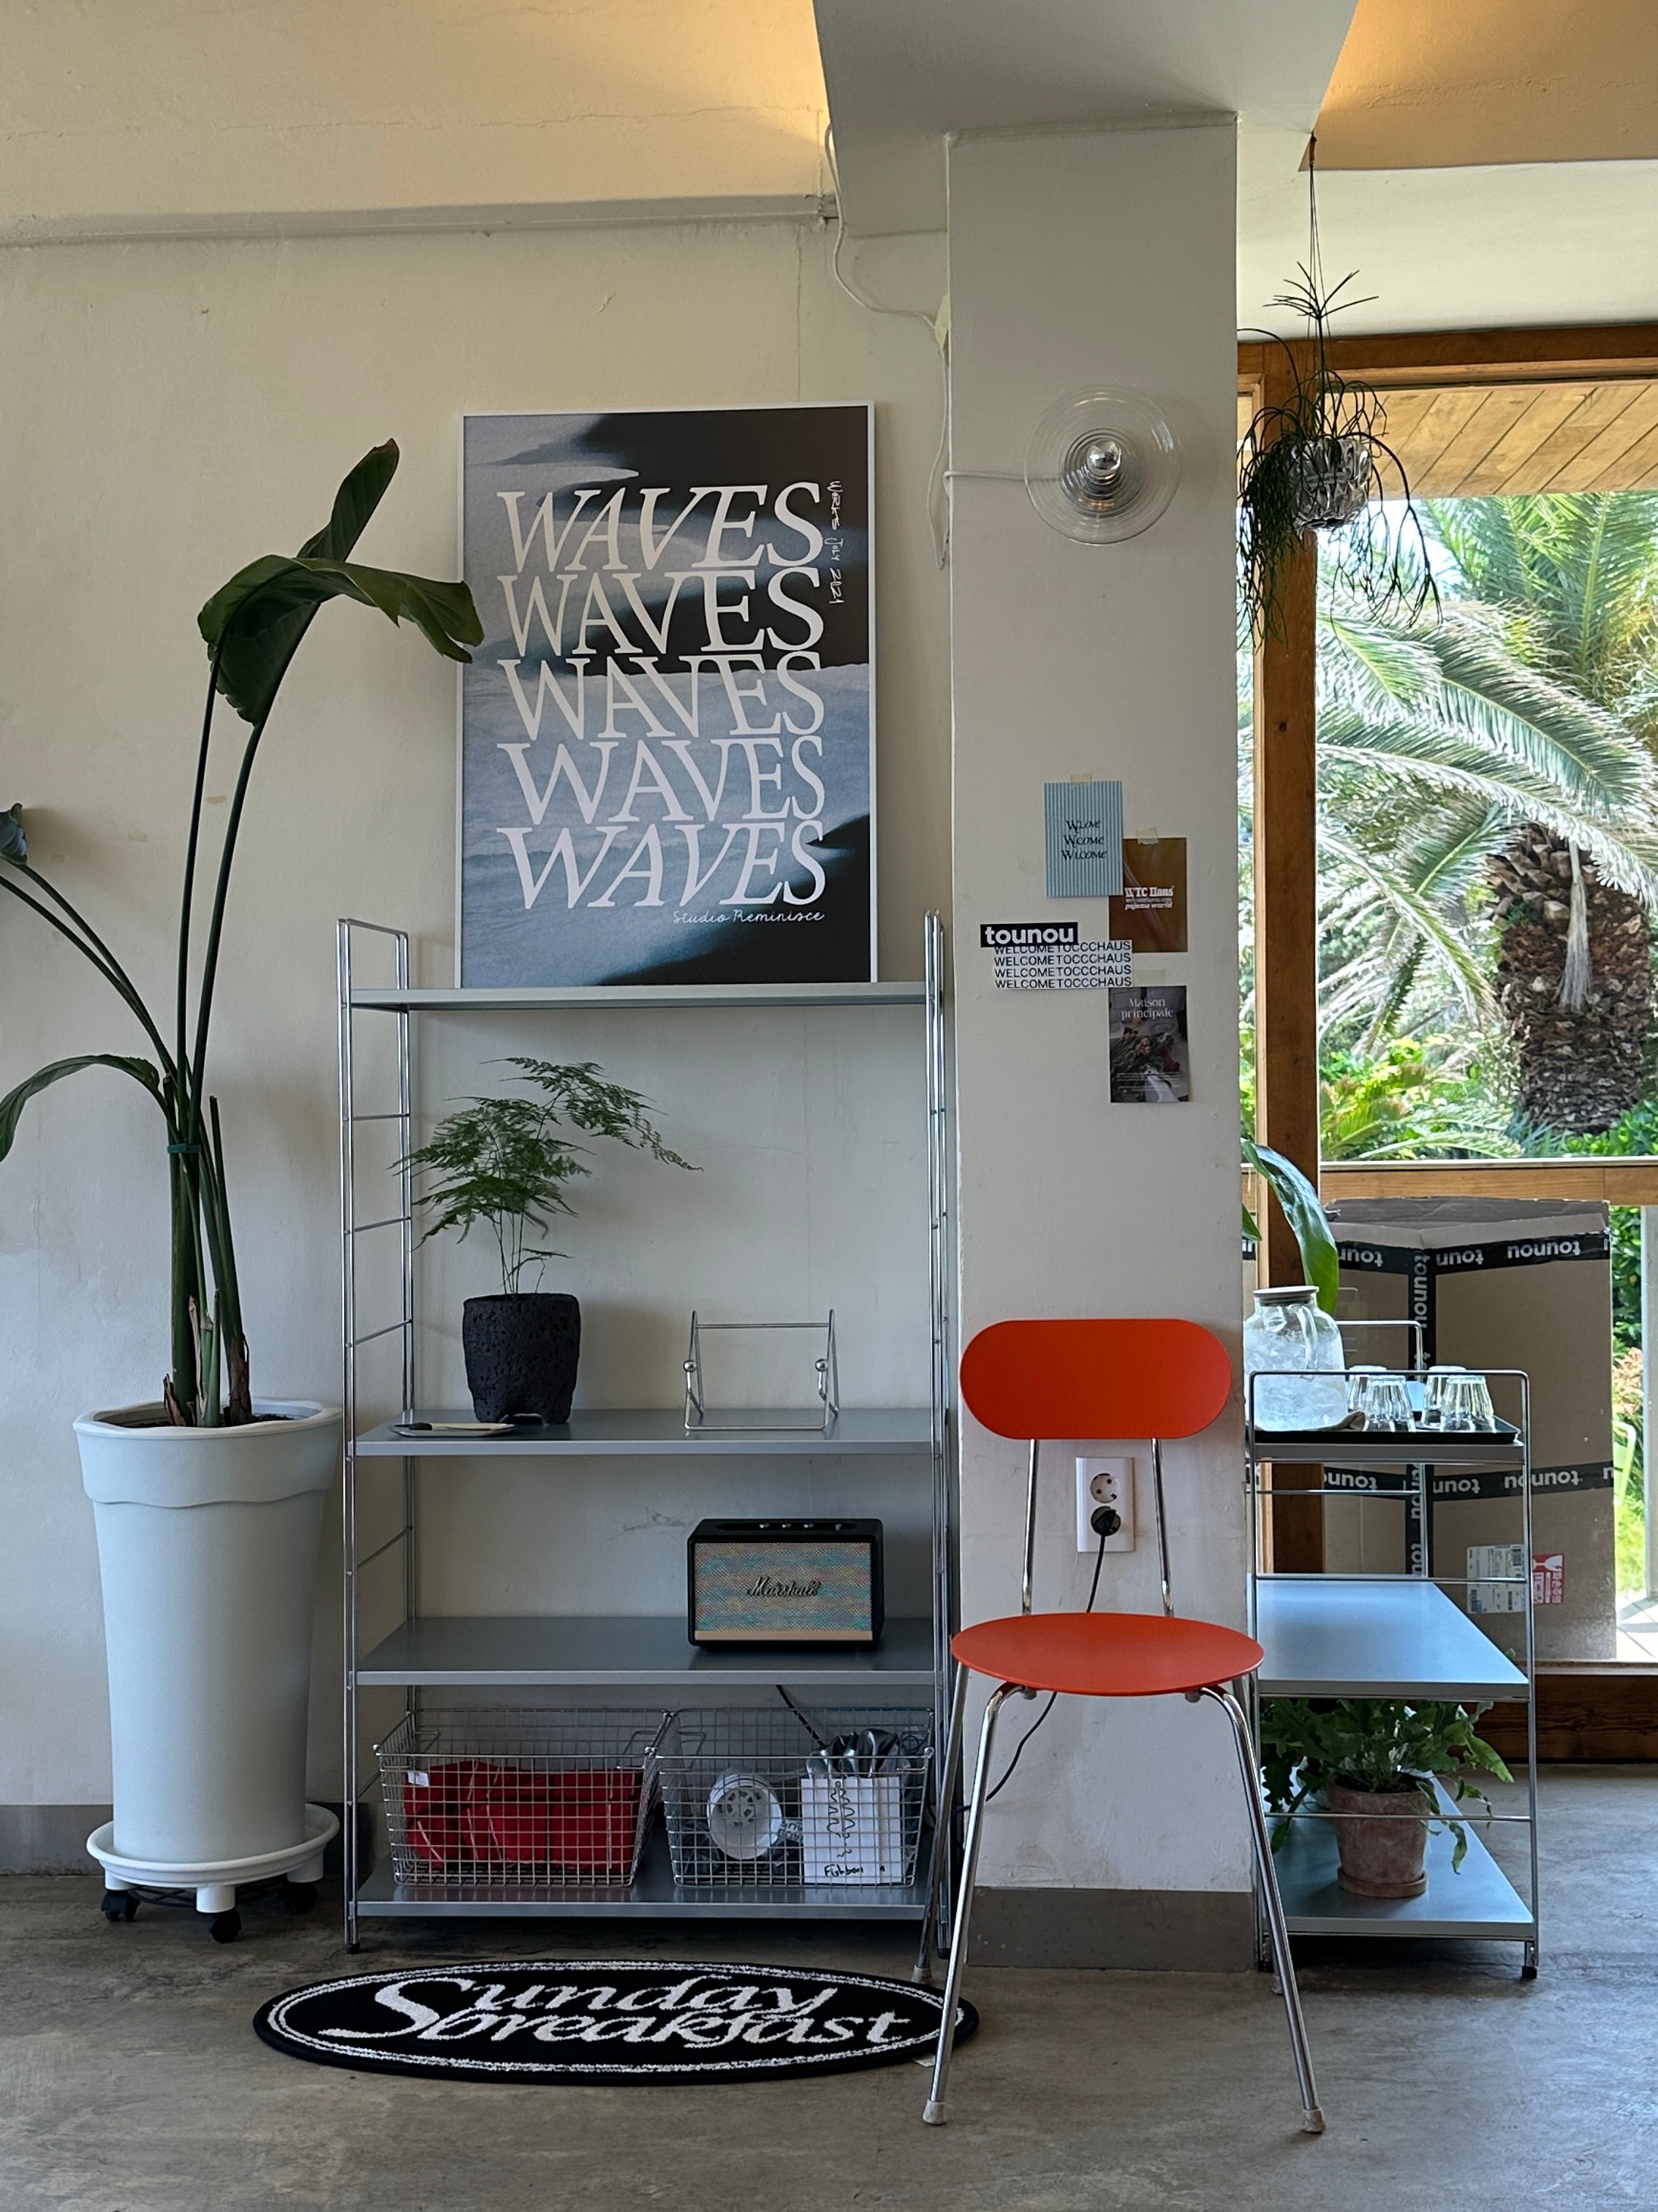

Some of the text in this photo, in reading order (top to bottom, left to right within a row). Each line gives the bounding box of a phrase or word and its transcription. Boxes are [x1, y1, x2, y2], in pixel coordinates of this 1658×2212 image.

[497, 482, 824, 572] WAVES
[829, 567, 844, 604] 2021
[497, 567, 824, 656] WAVES
[497, 652, 825, 741] WAVES
[496, 735, 825, 825] WAVES
[496, 819, 826, 909] WAVES
[673, 909, 825, 924] Studio Reminisce
[985, 926, 1074, 944] tounou
[994, 952, 1132, 966] WELCOMETOCCCHAUS
[994, 965, 1132, 978] WELCOMETOCCCHAUS
[995, 977, 1132, 989] WELCOMETOCCCHAUS
[1129, 998, 1165, 1007] Maison
[1121, 1008, 1174, 1020] principale
[1507, 1241, 1581, 1259] tounou
[746, 1576, 822, 1596] Marshall
[317, 1974, 838, 2038] Sunday
[417, 2007, 912, 2048] breakfast
